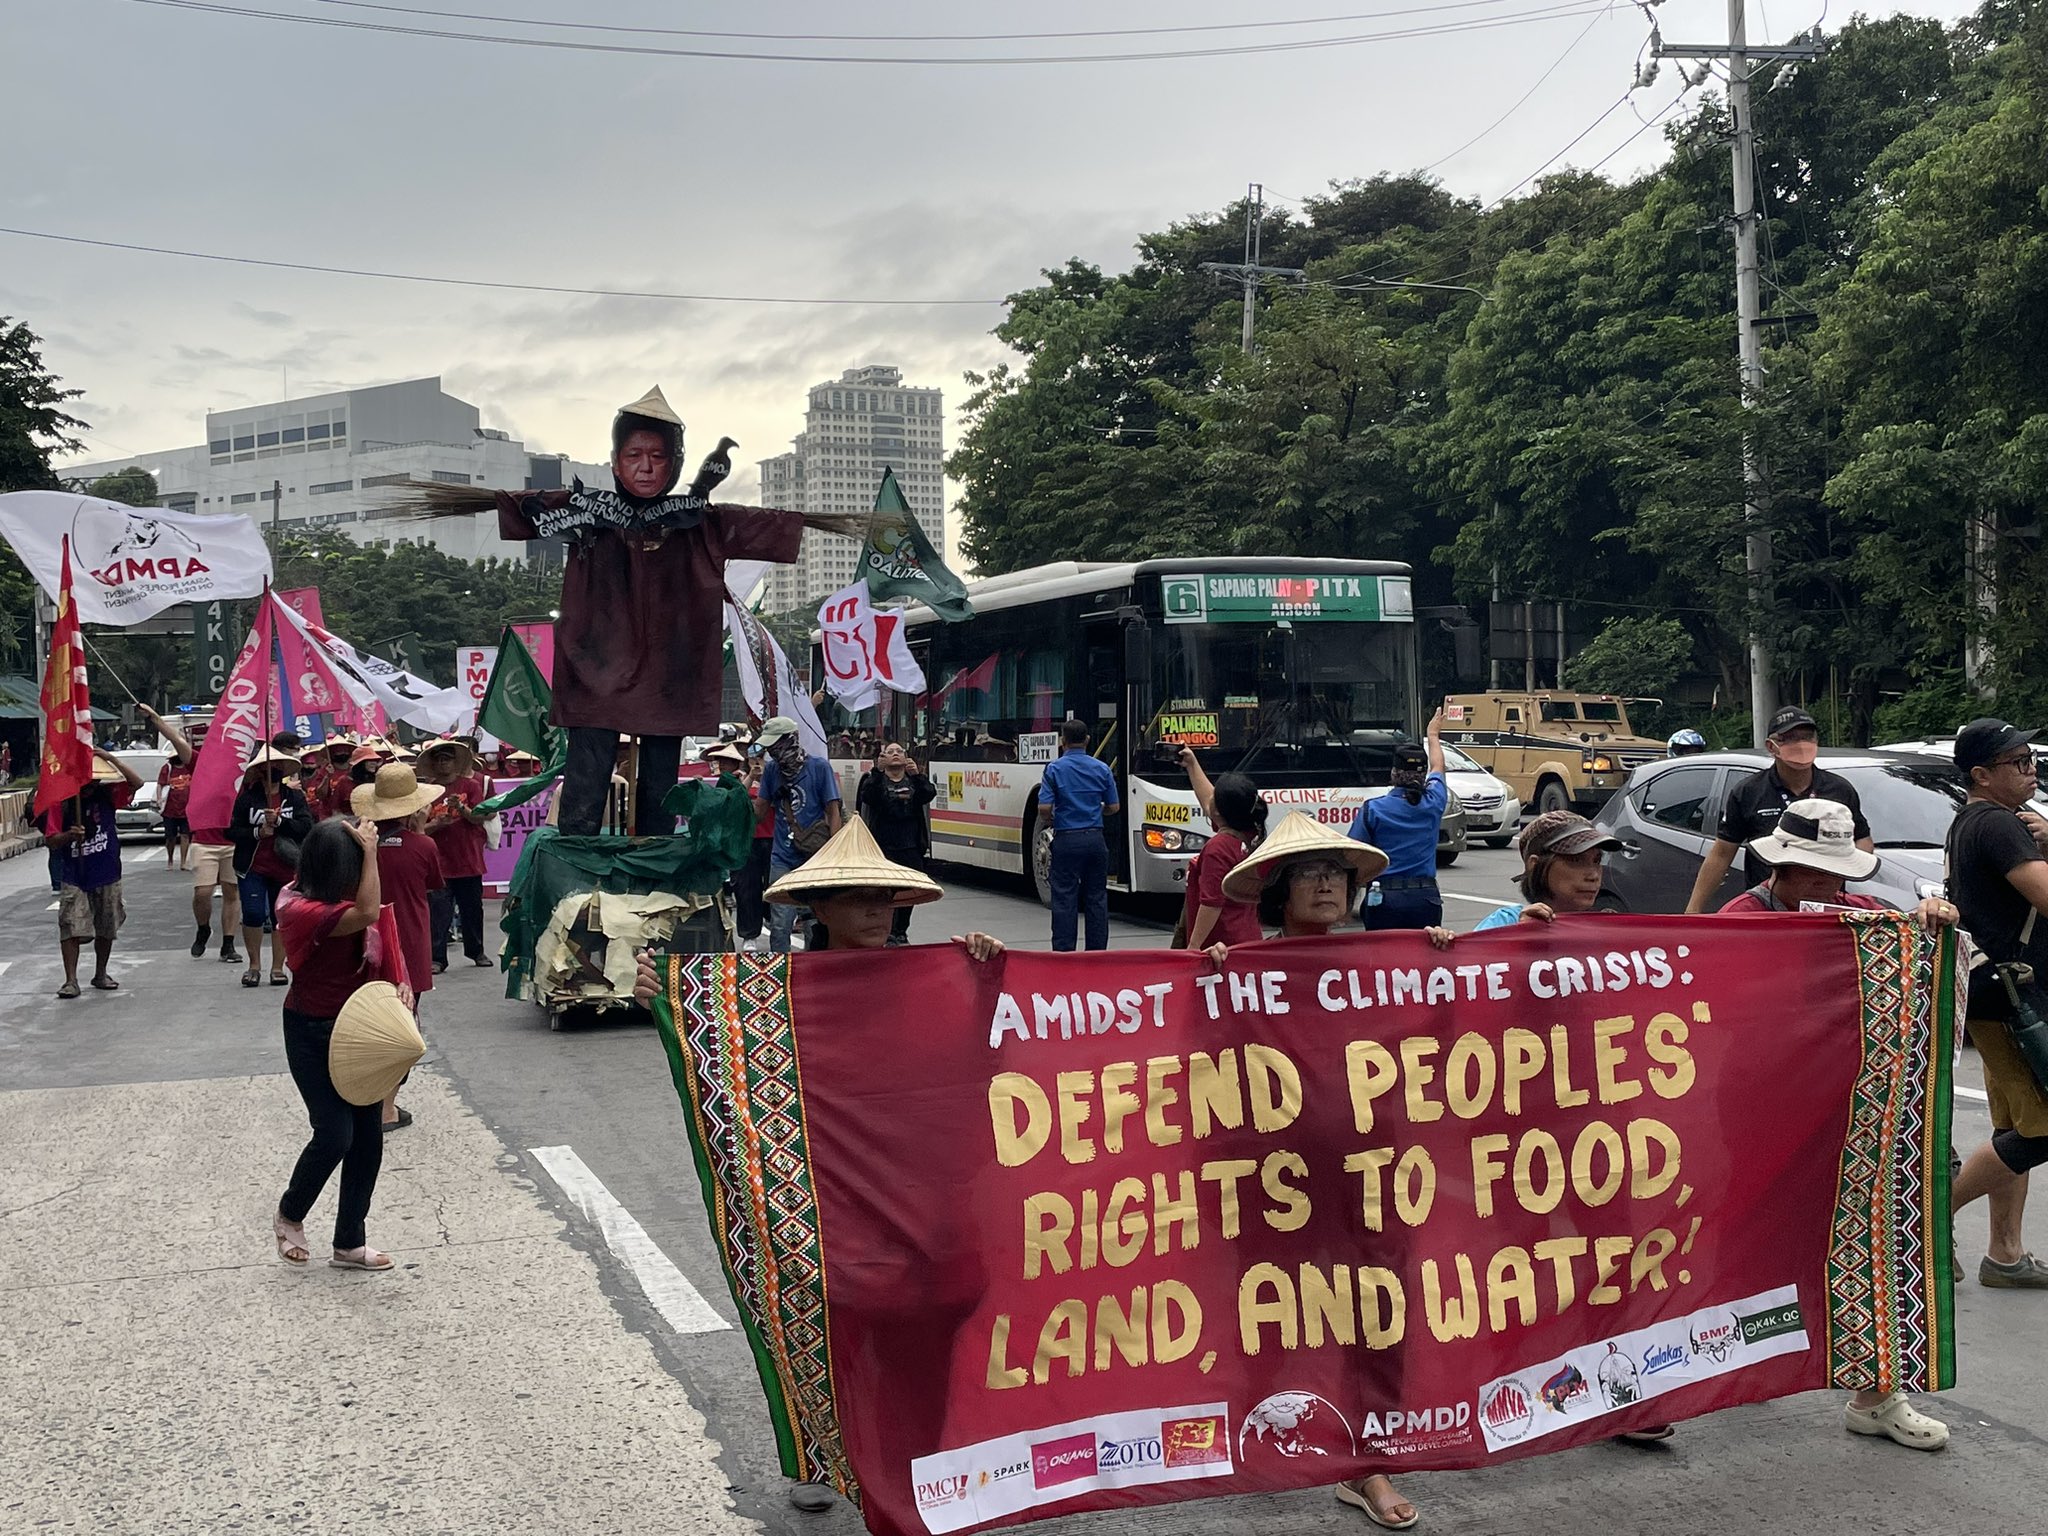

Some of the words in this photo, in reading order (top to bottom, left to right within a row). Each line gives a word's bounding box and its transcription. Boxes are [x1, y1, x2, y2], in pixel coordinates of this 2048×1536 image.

[569, 492, 632, 528] CONVERSION
[596, 491, 634, 517] LAND
[532, 508, 570, 526] LAND
[539, 512, 596, 537] GRABBING
[868, 552, 932, 581] OALITIO
[1210, 579, 1256, 598] SAPANG
[1258, 578, 1292, 597] PALAY
[1307, 578, 1361, 597] PITX
[1271, 603, 1321, 616] AIRCON
[1161, 715, 1217, 734] PALMERA
[1162, 733, 1217, 745] TUNGKO
[1261, 789, 1327, 805] GICLINE
[988, 981, 1174, 1049] AMIDST
[1195, 971, 1290, 1020] THE
[1317, 962, 1512, 1012] CLIMATE
[1528, 945, 1695, 998] CRISIS:
[988, 1043, 1303, 1168] DEFEND
[1345, 1001, 1712, 1134] PEOPLES'
[1022, 1149, 1312, 1280] RIGHTS
[1343, 1145, 1437, 1232] TO
[1471, 1117, 1694, 1218] FOOD,
[985, 1279, 1218, 1390] LAND,
[1239, 1261, 1406, 1356] AND
[1420, 1215, 1703, 1344] WATER!
[1782, 1310, 1800, 1322] QC
[1699, 1325, 1730, 1341] BMP
[1361, 1401, 1470, 1439] APMDD
[1400, 1445, 1417, 1454] AND
[993, 1460, 1030, 1478] SPARK
